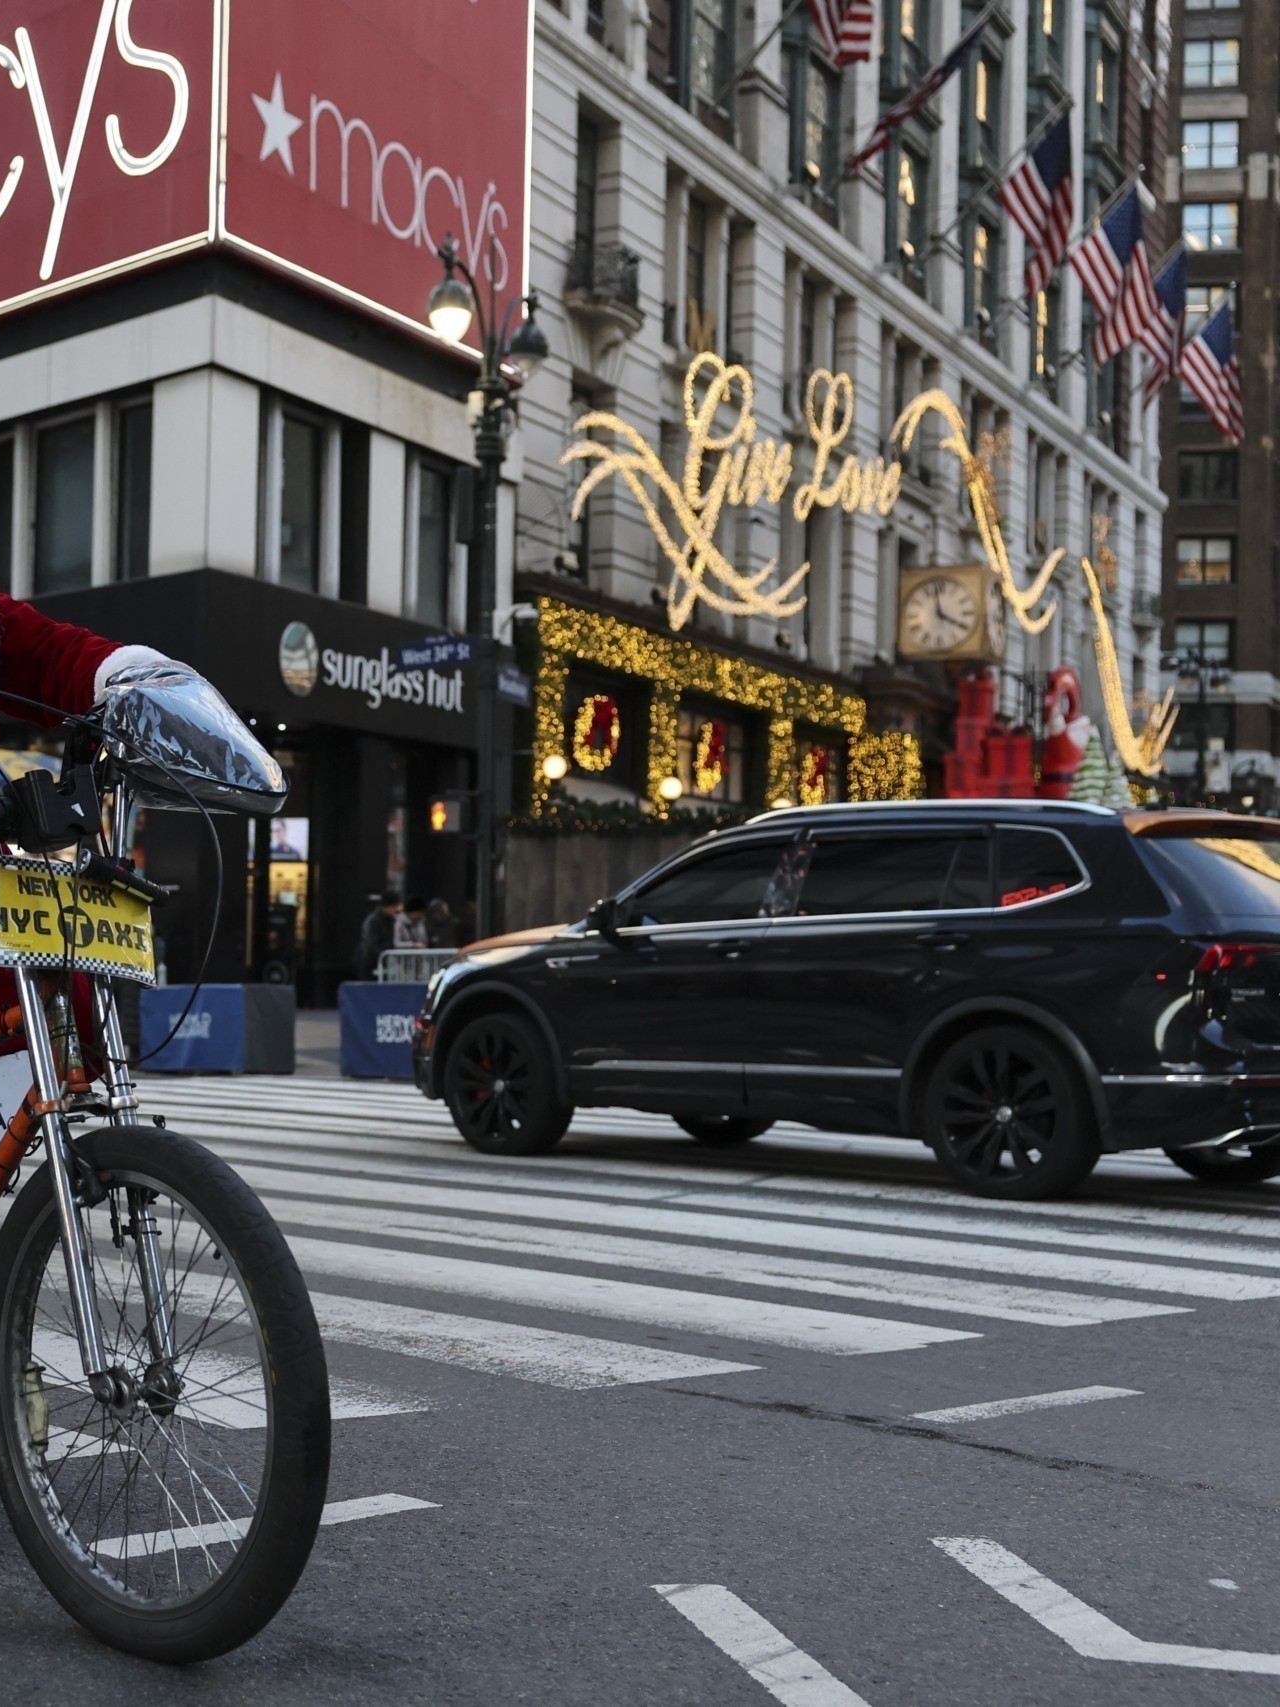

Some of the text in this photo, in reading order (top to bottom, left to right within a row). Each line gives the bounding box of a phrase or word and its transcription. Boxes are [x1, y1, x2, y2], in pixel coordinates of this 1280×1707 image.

[401, 649, 432, 666] West
[322, 646, 425, 710] sunglass
[427, 668, 465, 713] hut
[17, 875, 117, 908] NEW YORK
